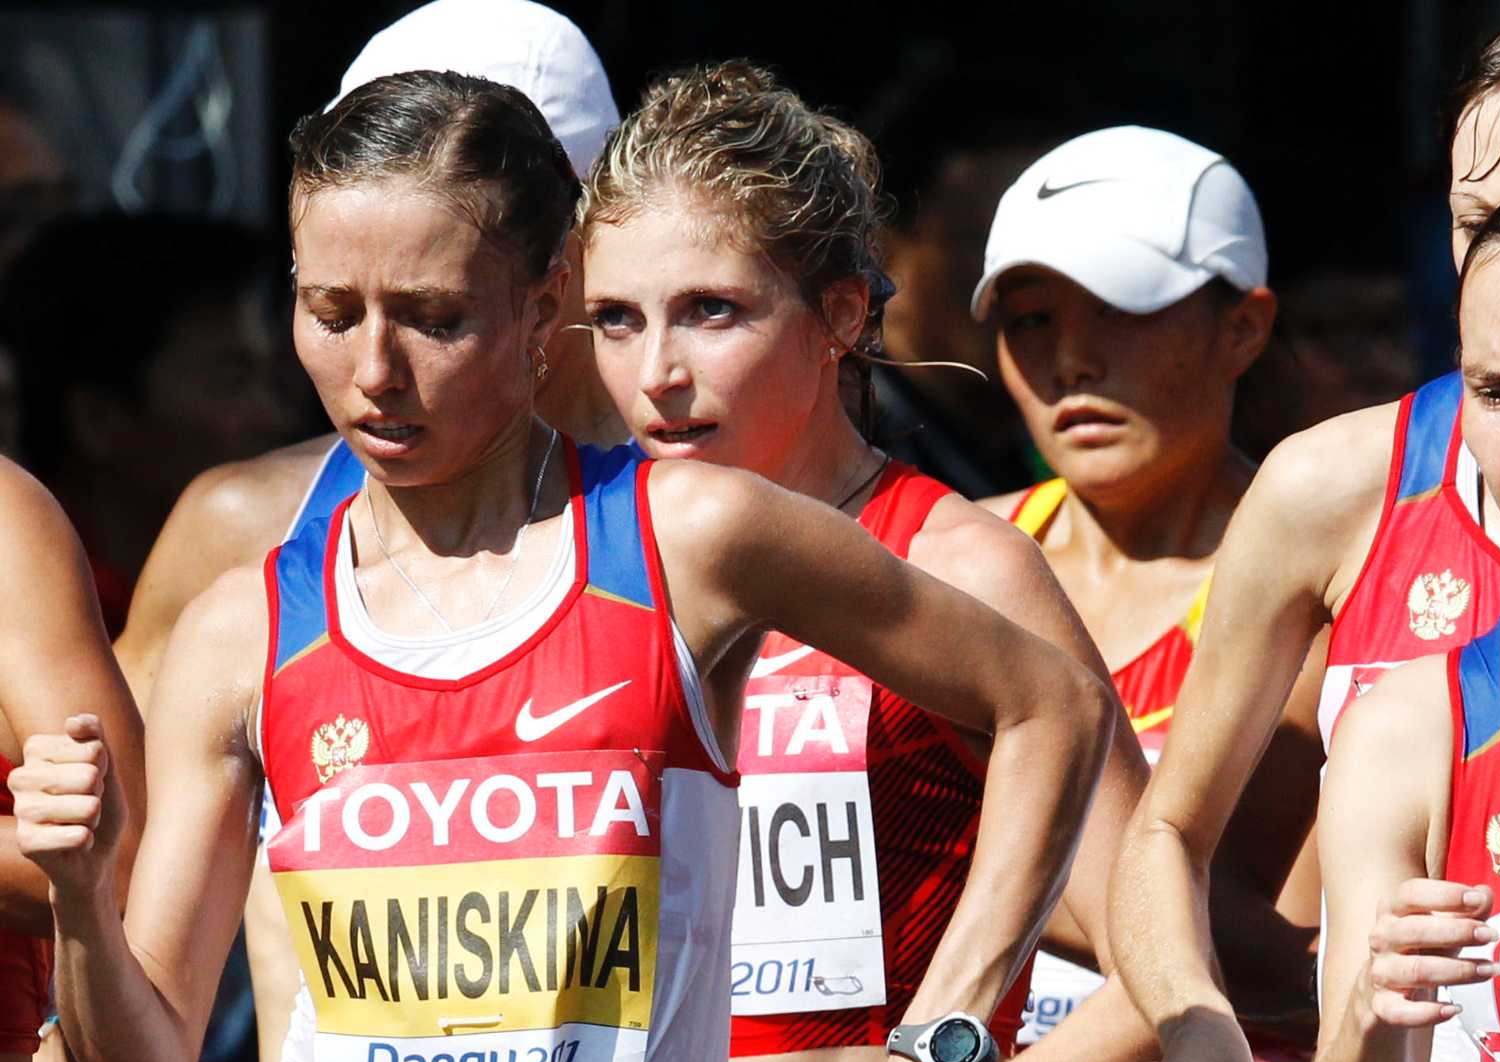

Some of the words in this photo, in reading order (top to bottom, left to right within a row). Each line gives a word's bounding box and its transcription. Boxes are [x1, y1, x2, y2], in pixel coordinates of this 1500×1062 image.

[300, 769, 650, 852] TOYOTA
[301, 886, 641, 1003] KANISKINA
[731, 957, 816, 997] 2011
